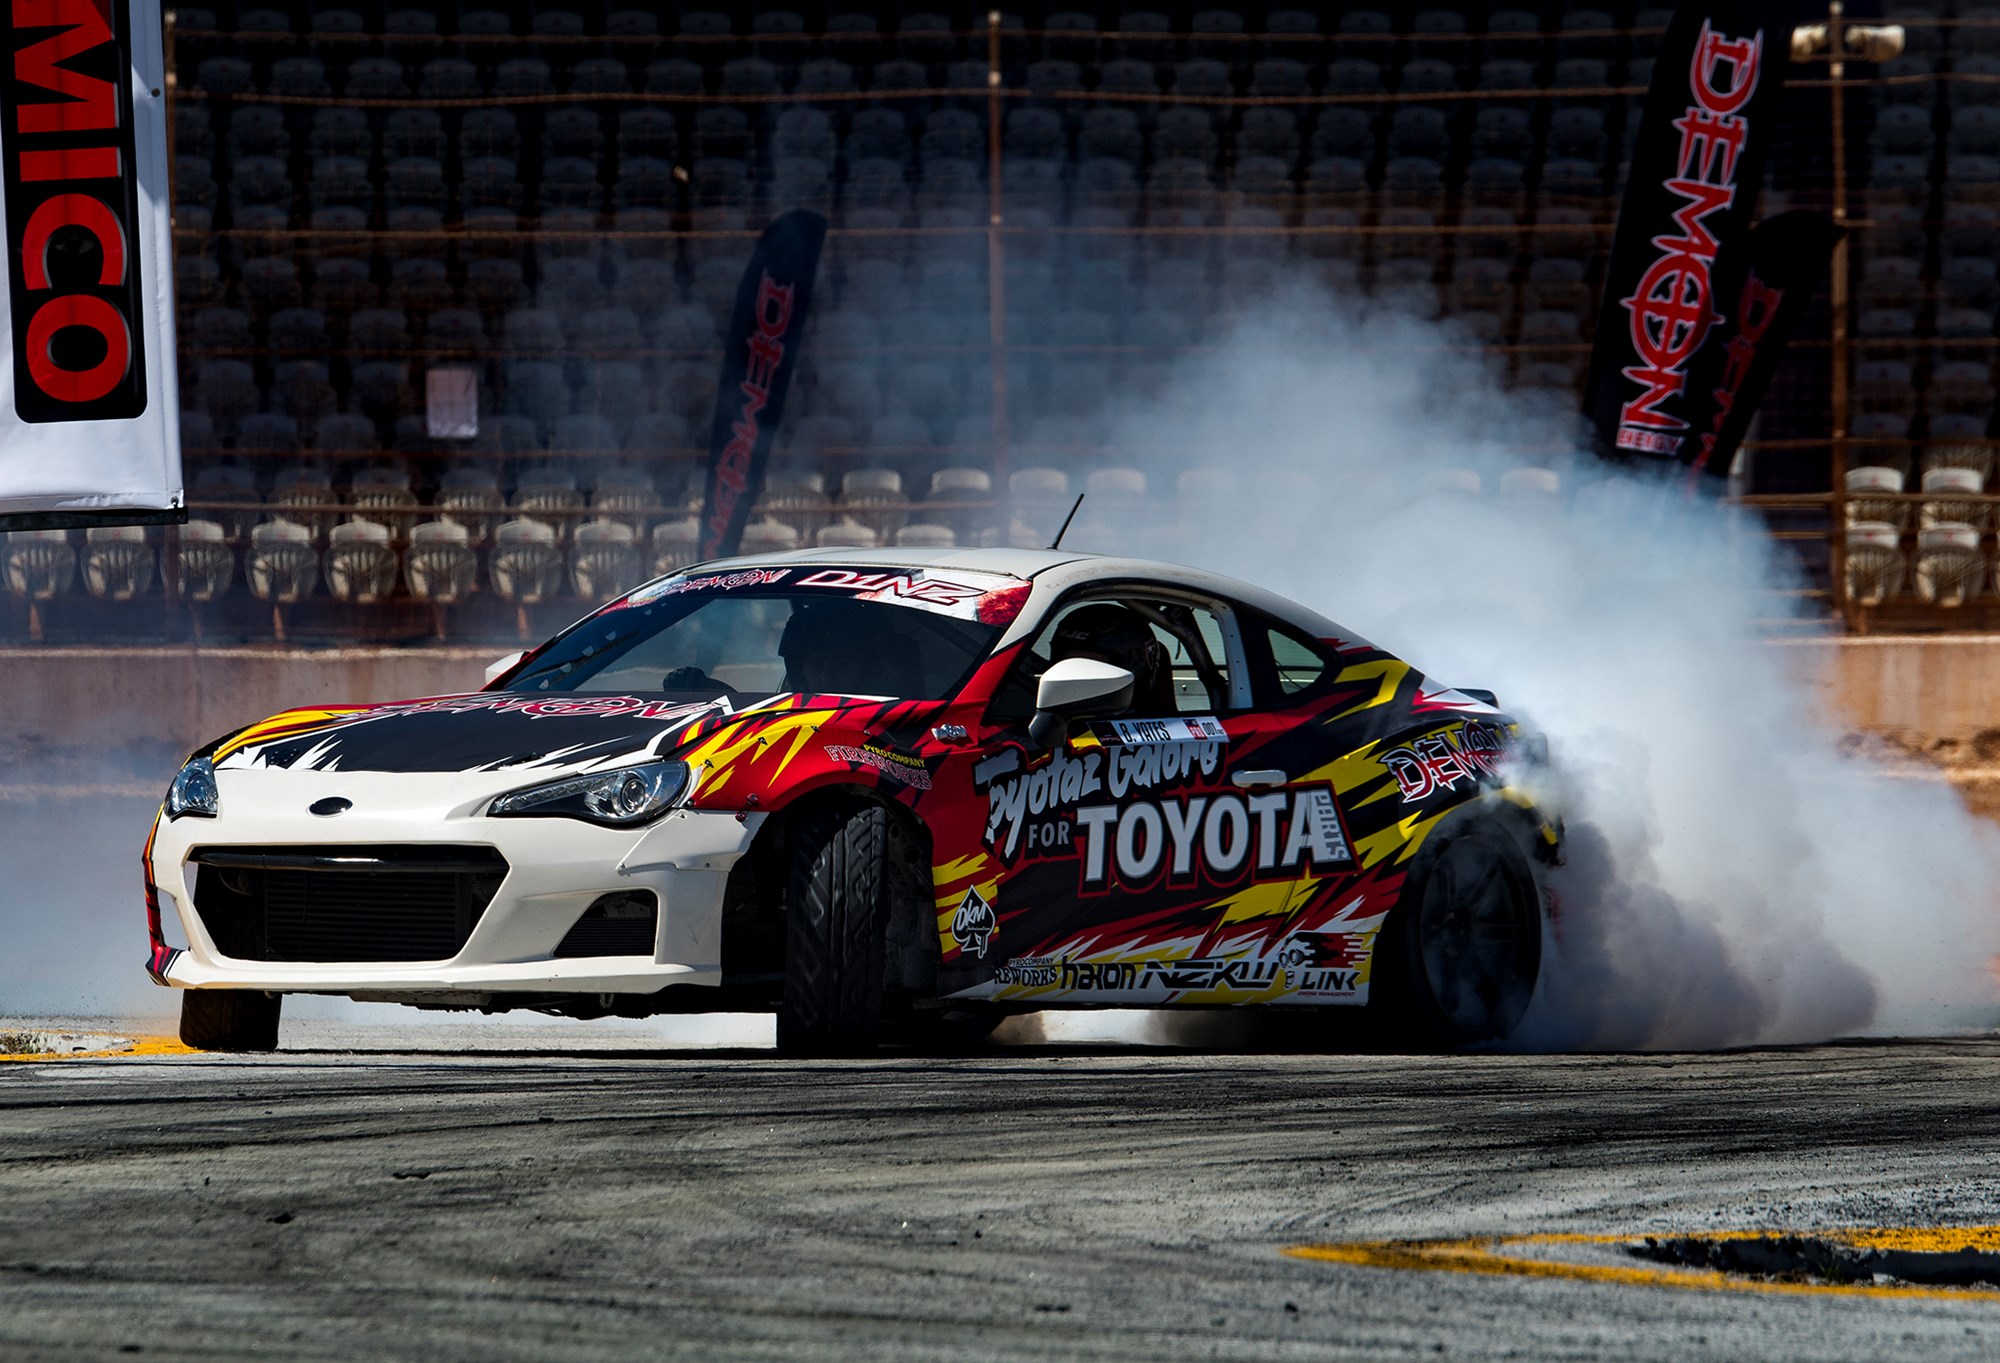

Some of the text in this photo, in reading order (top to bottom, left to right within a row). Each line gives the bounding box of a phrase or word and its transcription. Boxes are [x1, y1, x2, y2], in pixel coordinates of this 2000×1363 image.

[1620, 17, 1764, 430] DEMON
[1616, 428, 1686, 456] ENERGY
[795, 569, 988, 606] D1NZ
[1133, 722, 1172, 742] YATES
[1202, 722, 1218, 736] 001
[824, 745, 932, 790] FIREWORKS
[974, 743, 1219, 858] Toyotaz Galore
[1028, 788, 1352, 882] FOR TOYOTA
[1314, 795, 1352, 860] PARTS
[1301, 971, 1360, 991] LINK
